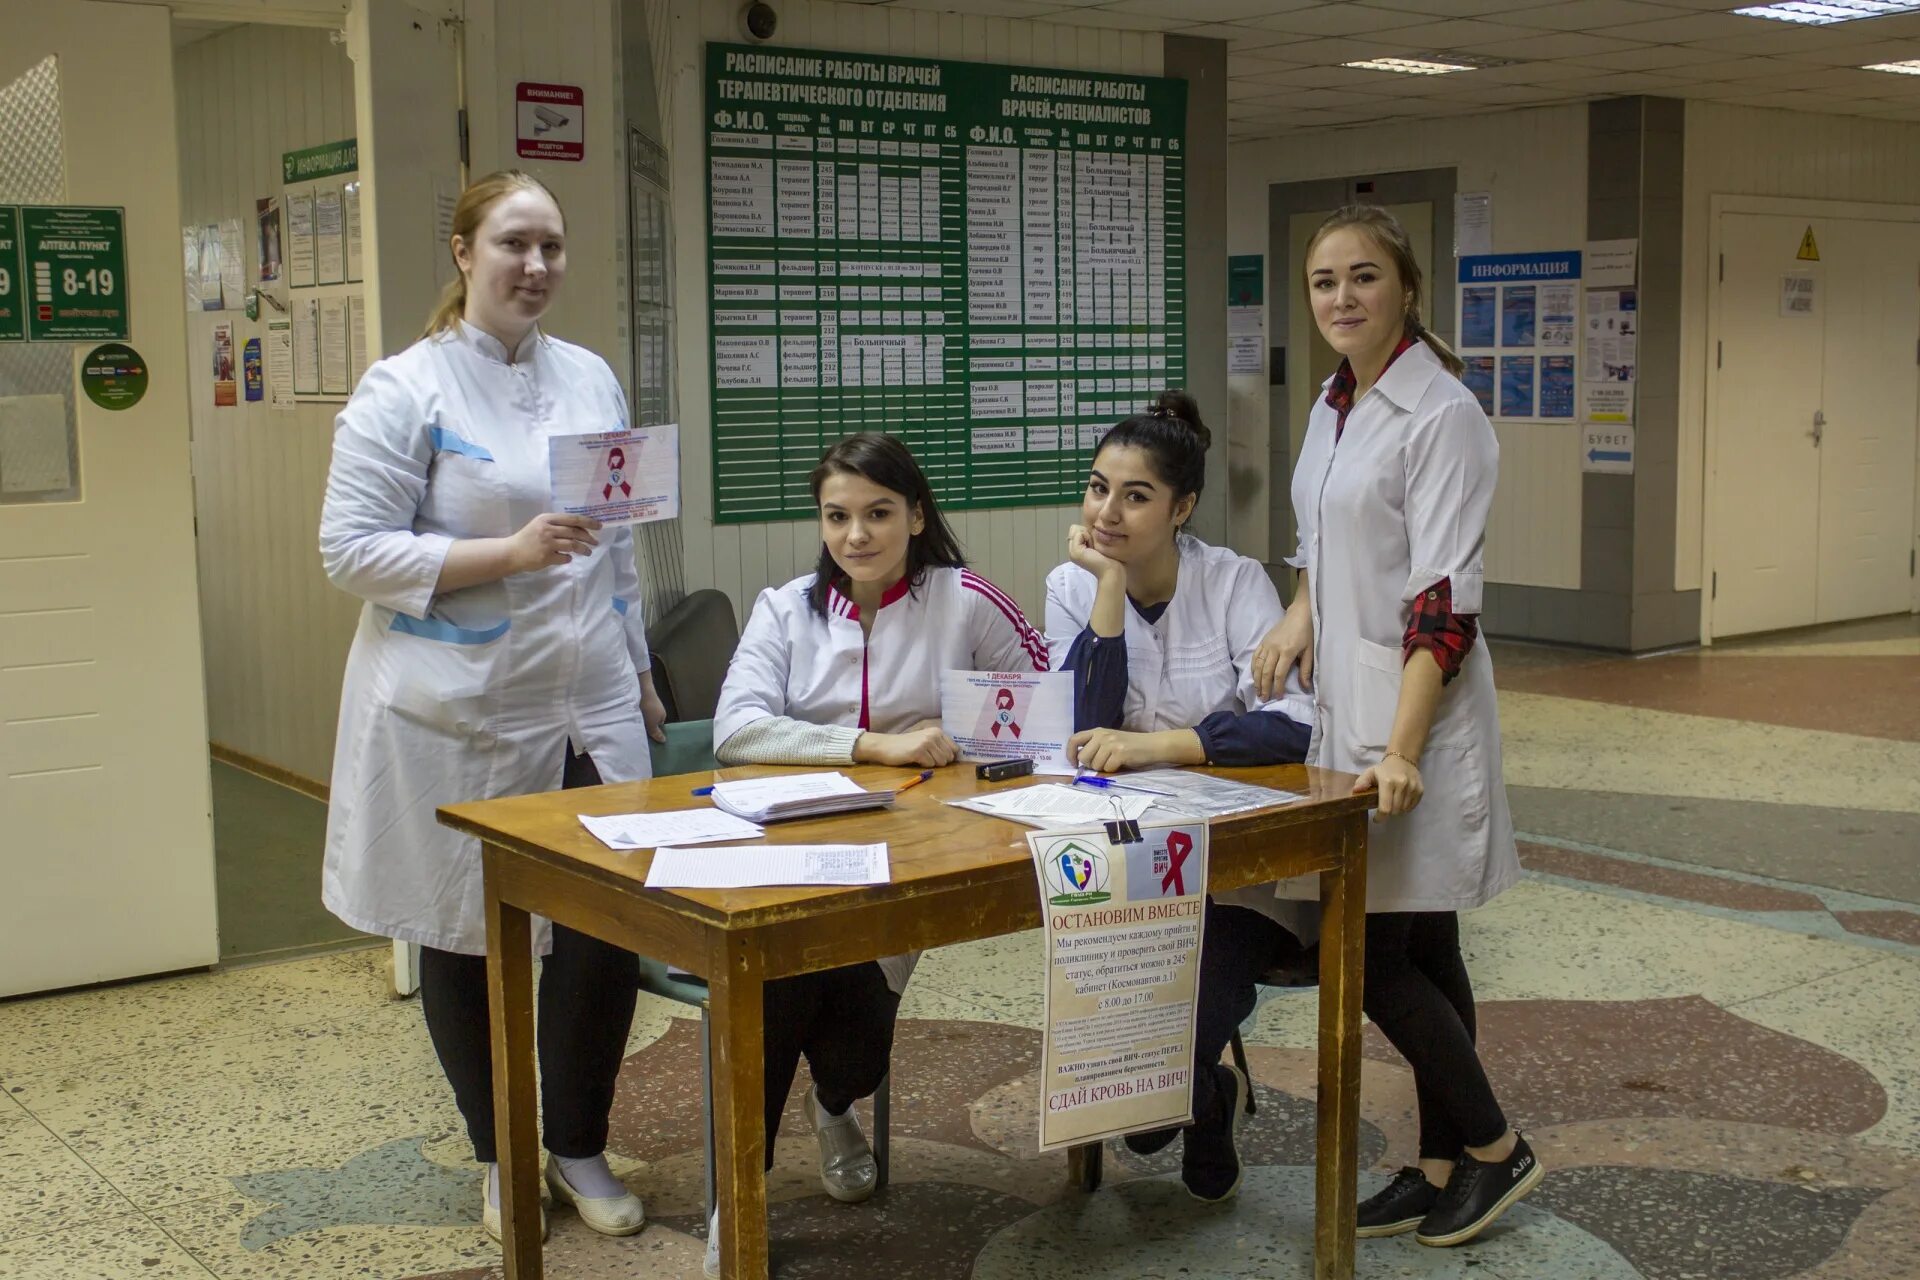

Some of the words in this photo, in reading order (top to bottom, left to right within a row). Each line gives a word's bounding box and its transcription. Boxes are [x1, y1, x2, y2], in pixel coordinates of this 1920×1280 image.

[726, 52, 822, 75] РАСПИСАНИЕ
[825, 61, 884, 82] РАБОТЫ
[888, 65, 941, 86] ВРАЧЕЙ
[717, 79, 863, 107] ТЕРАПЕВТИЧЕСКОГО
[866, 89, 947, 112] ОТДЕЛЕНИЯ
[1010, 74, 1091, 96] РАСПИСАНИЕ
[1094, 81, 1145, 101] РАБОТЫ
[713, 110, 768, 131] Ф.И.О.
[1001, 99, 1150, 125] ВРАЧЕЙ-СПЕЦИАЛИСТОВ
[839, 119, 854, 132] ПН
[861, 120, 875, 133] ВТ
[882, 121, 896, 134] СР
[903, 122, 916, 135] ЧТ
[924, 123, 936, 136] ПТ
[944, 125, 957, 137] СБ
[970, 125, 1017, 144] Ф.И.О.
[1077, 133, 1090, 145] ПН
[1096, 134, 1108, 146] ВТ
[1115, 135, 1126, 147] СР
[1132, 136, 1144, 149] ЧТ
[1151, 137, 1161, 149] ПТ
[1169, 138, 1179, 150] СБ
[1086, 165, 1131, 175] Больничный
[39, 240, 77, 251] АПТЕКА
[78, 241, 111, 251] ПУНКТ
[1472, 262, 1570, 278] ИНФОРМАЦИЯ
[63, 268, 114, 296] 8-19
[854, 337, 906, 346] Больничный
[1588, 434, 1628, 446] БУФЕТ
[1154, 862, 1168, 874] ВИЧ
[1053, 907, 1144, 931] ОСТАНОВИМ
[1148, 901, 1200, 920] ВМЕСТЕ
[1057, 937, 1071, 950] Мы
[1075, 932, 1127, 949] рекомендуем
[1129, 928, 1162, 943] каждому
[1164, 925, 1191, 938] прийти
[1054, 951, 1109, 966] поликлинику
[1117, 946, 1156, 961] проверить
[1158, 943, 1175, 952] свой
[1066, 967, 1094, 981] статус,
[1096, 962, 1138, 978] обратиться
[1140, 959, 1165, 971] можно
[1173, 953, 1186, 965] 245
[1075, 981, 1106, 995] кабинет
[1108, 974, 1161, 992] (Космонавтов
[1122, 997, 1132, 1006] до
[1058, 1063, 1086, 1075] ВАЖНО
[1049, 1089, 1086, 1111] СДАЙ
[1091, 1082, 1133, 1102] КРОВЬ
[1136, 1077, 1154, 1094] НА
[1158, 1070, 1187, 1089] ВИЧ!
